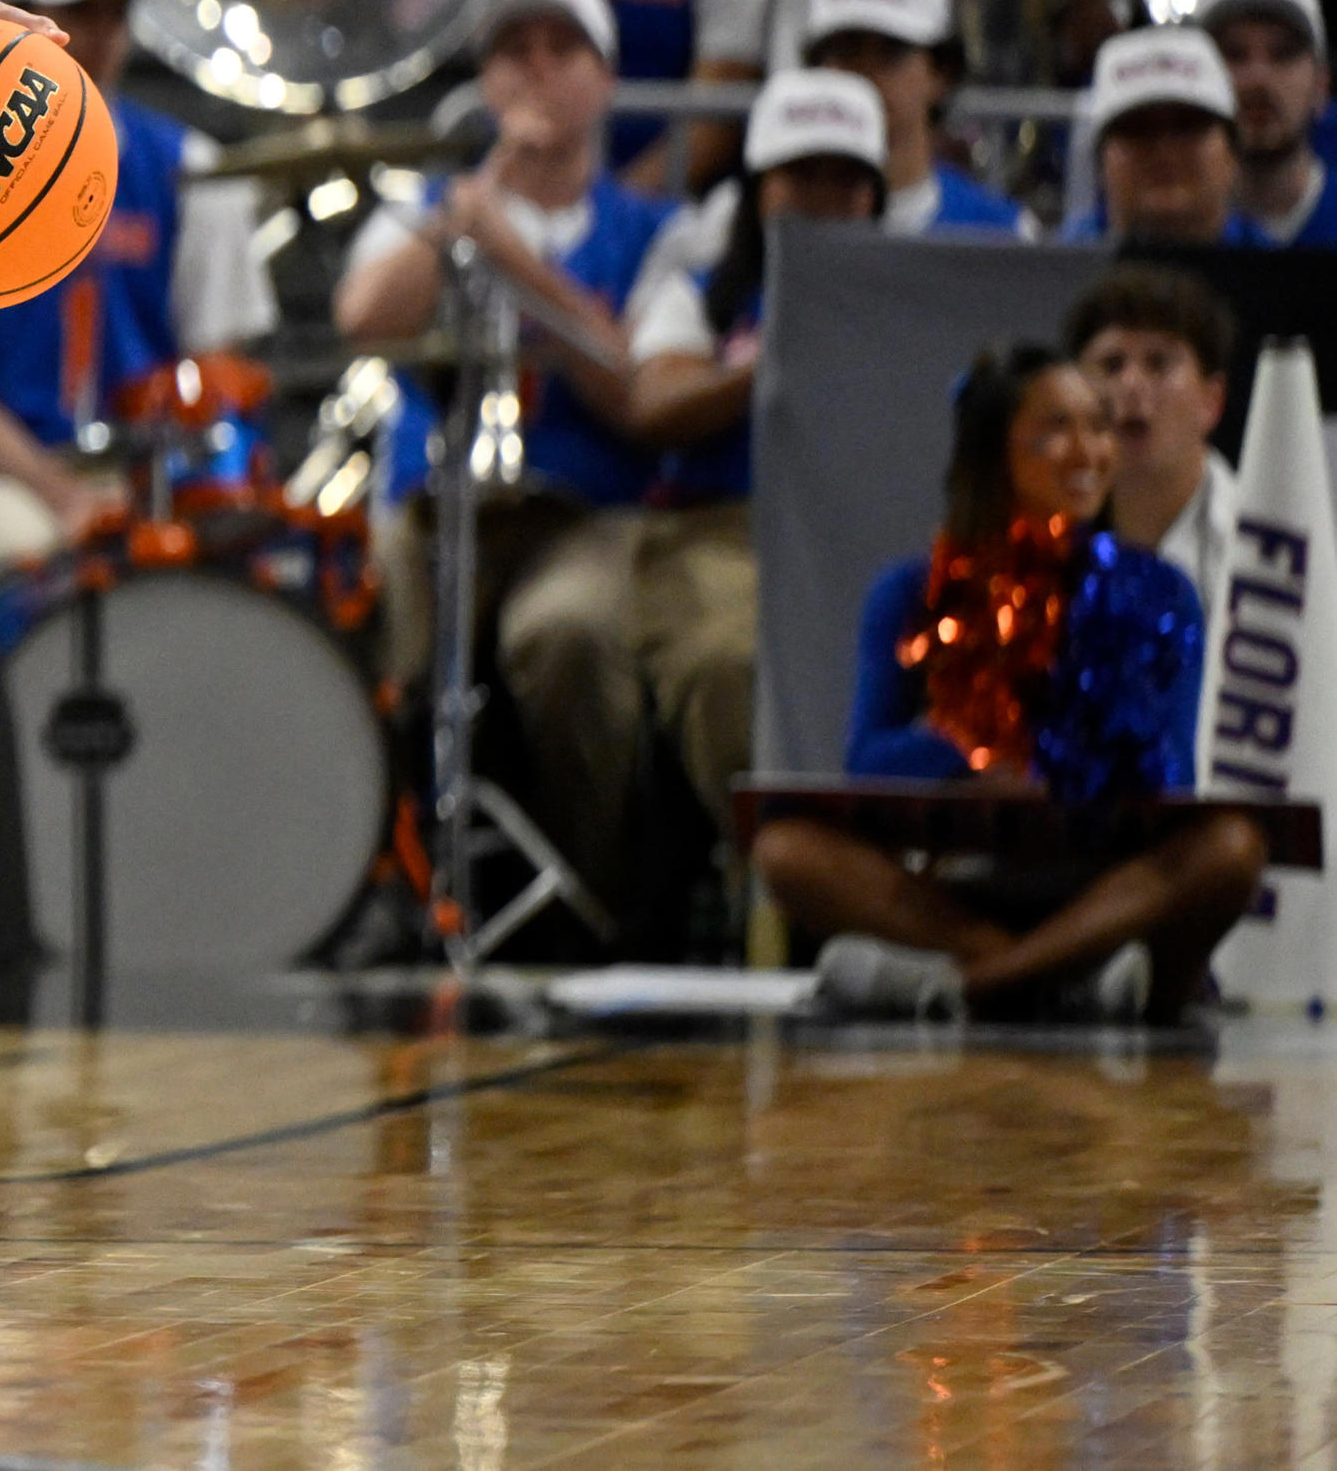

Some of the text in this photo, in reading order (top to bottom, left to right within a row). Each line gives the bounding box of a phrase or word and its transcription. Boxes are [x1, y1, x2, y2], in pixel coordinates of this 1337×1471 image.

[0, 151, 38, 205] OFFICIAL
[32, 119, 55, 151] GAME
[1211, 514, 1309, 920] FLORI
